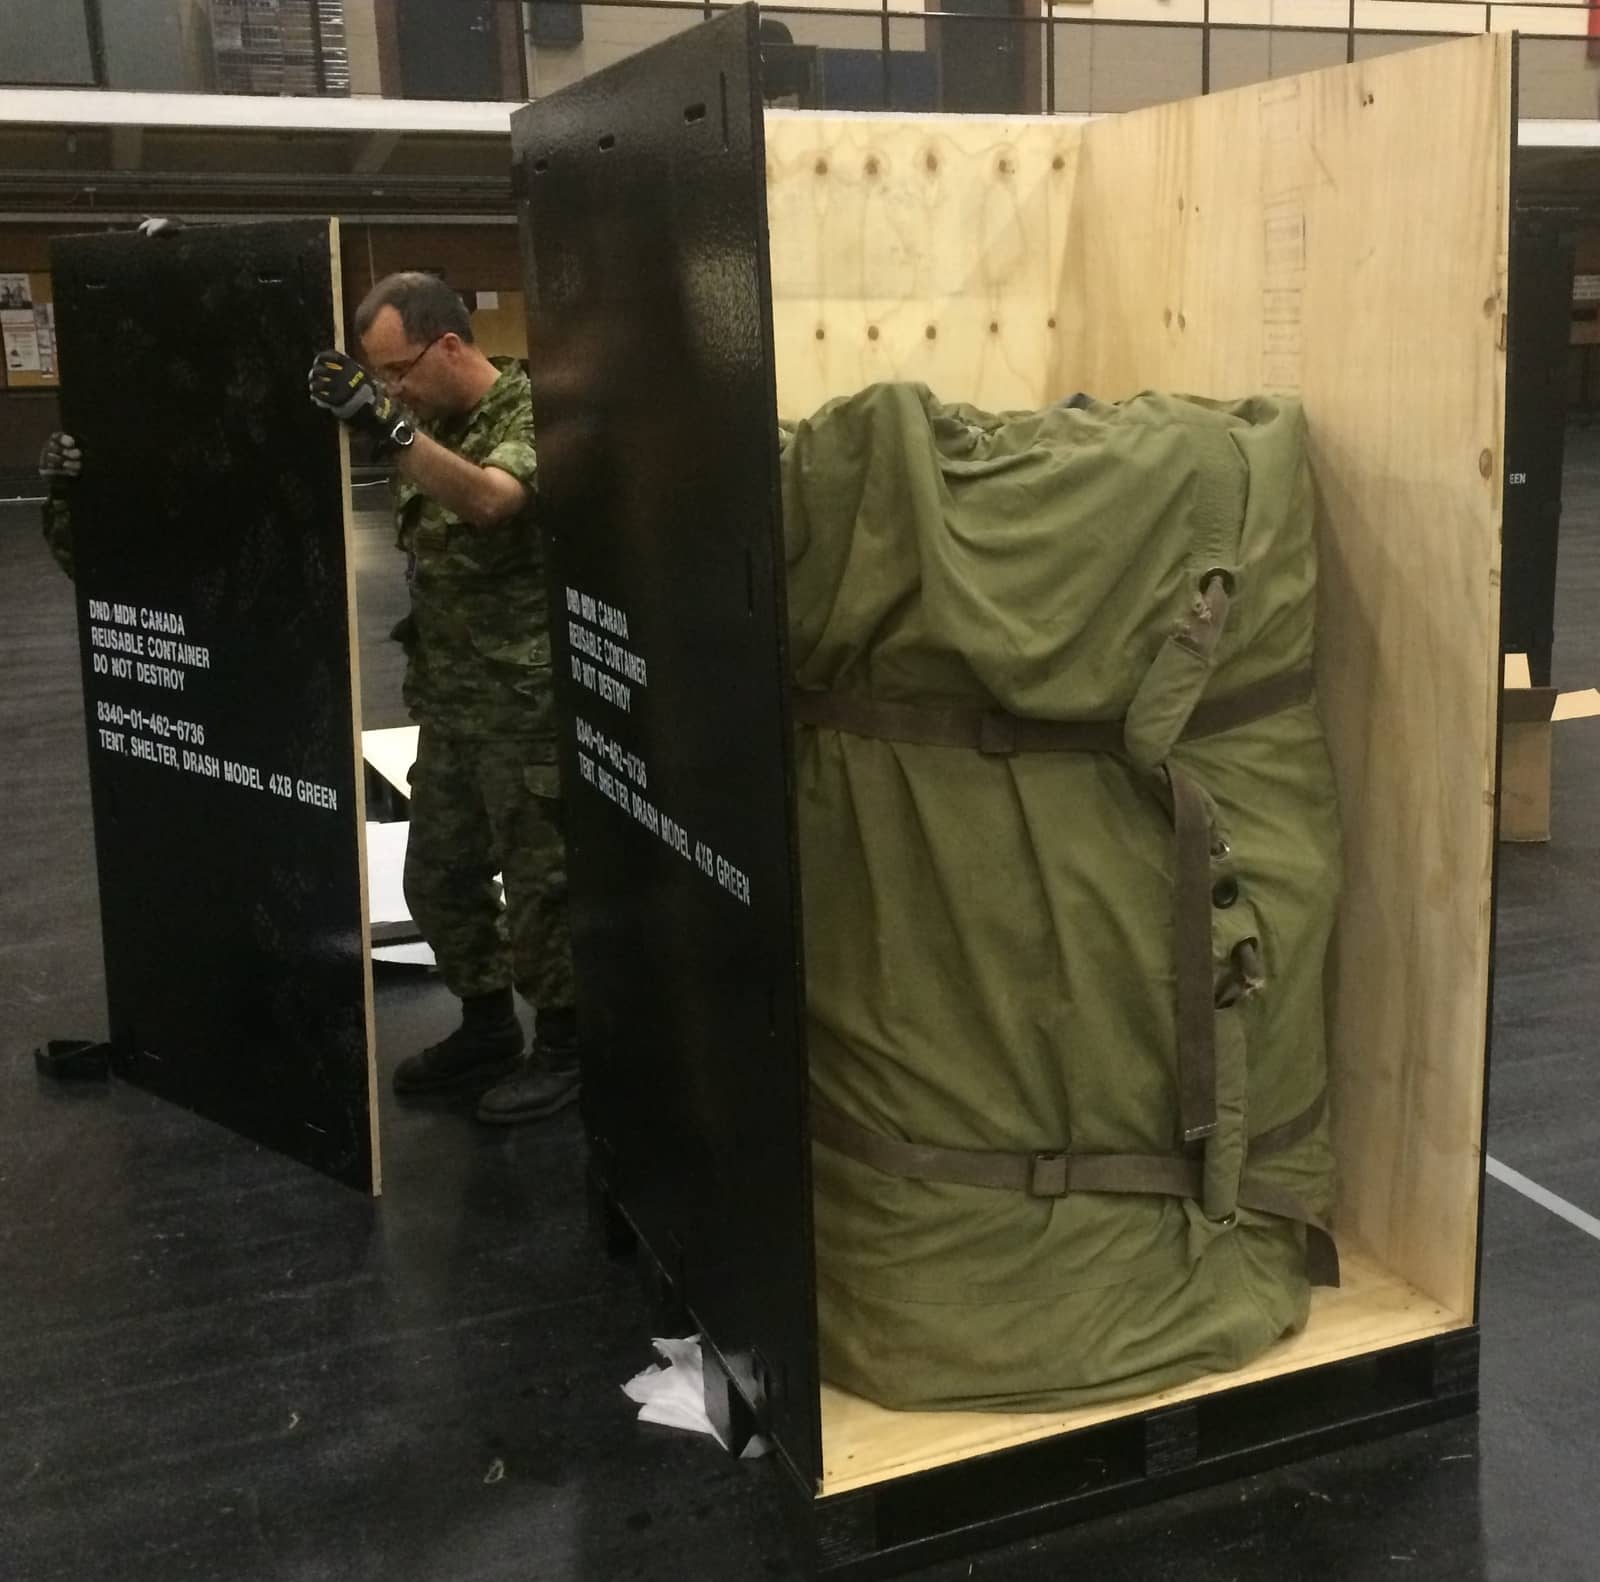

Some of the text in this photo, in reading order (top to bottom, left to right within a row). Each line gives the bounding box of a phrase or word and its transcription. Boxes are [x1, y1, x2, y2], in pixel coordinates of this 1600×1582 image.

[1508, 472, 1526, 485] EEN
[140, 607, 185, 636] CANADA
[598, 600, 629, 641] CANADA
[91, 626, 210, 669] REUSABLE CONTAINER
[568, 620, 648, 687] REUSABLE CONTAINER
[93, 653, 185, 691] DO NOT DESTROY
[570, 654, 631, 713] DO NOT DESTROY
[97, 700, 205, 746] 8340-01-462-6736
[182, 750, 220, 779] DRASH
[223, 760, 264, 791] MODEL
[296, 778, 337, 811] GREEN
[632, 791, 659, 836] DRASH
[660, 812, 692, 861] MODEL
[715, 854, 751, 906] GREEN
